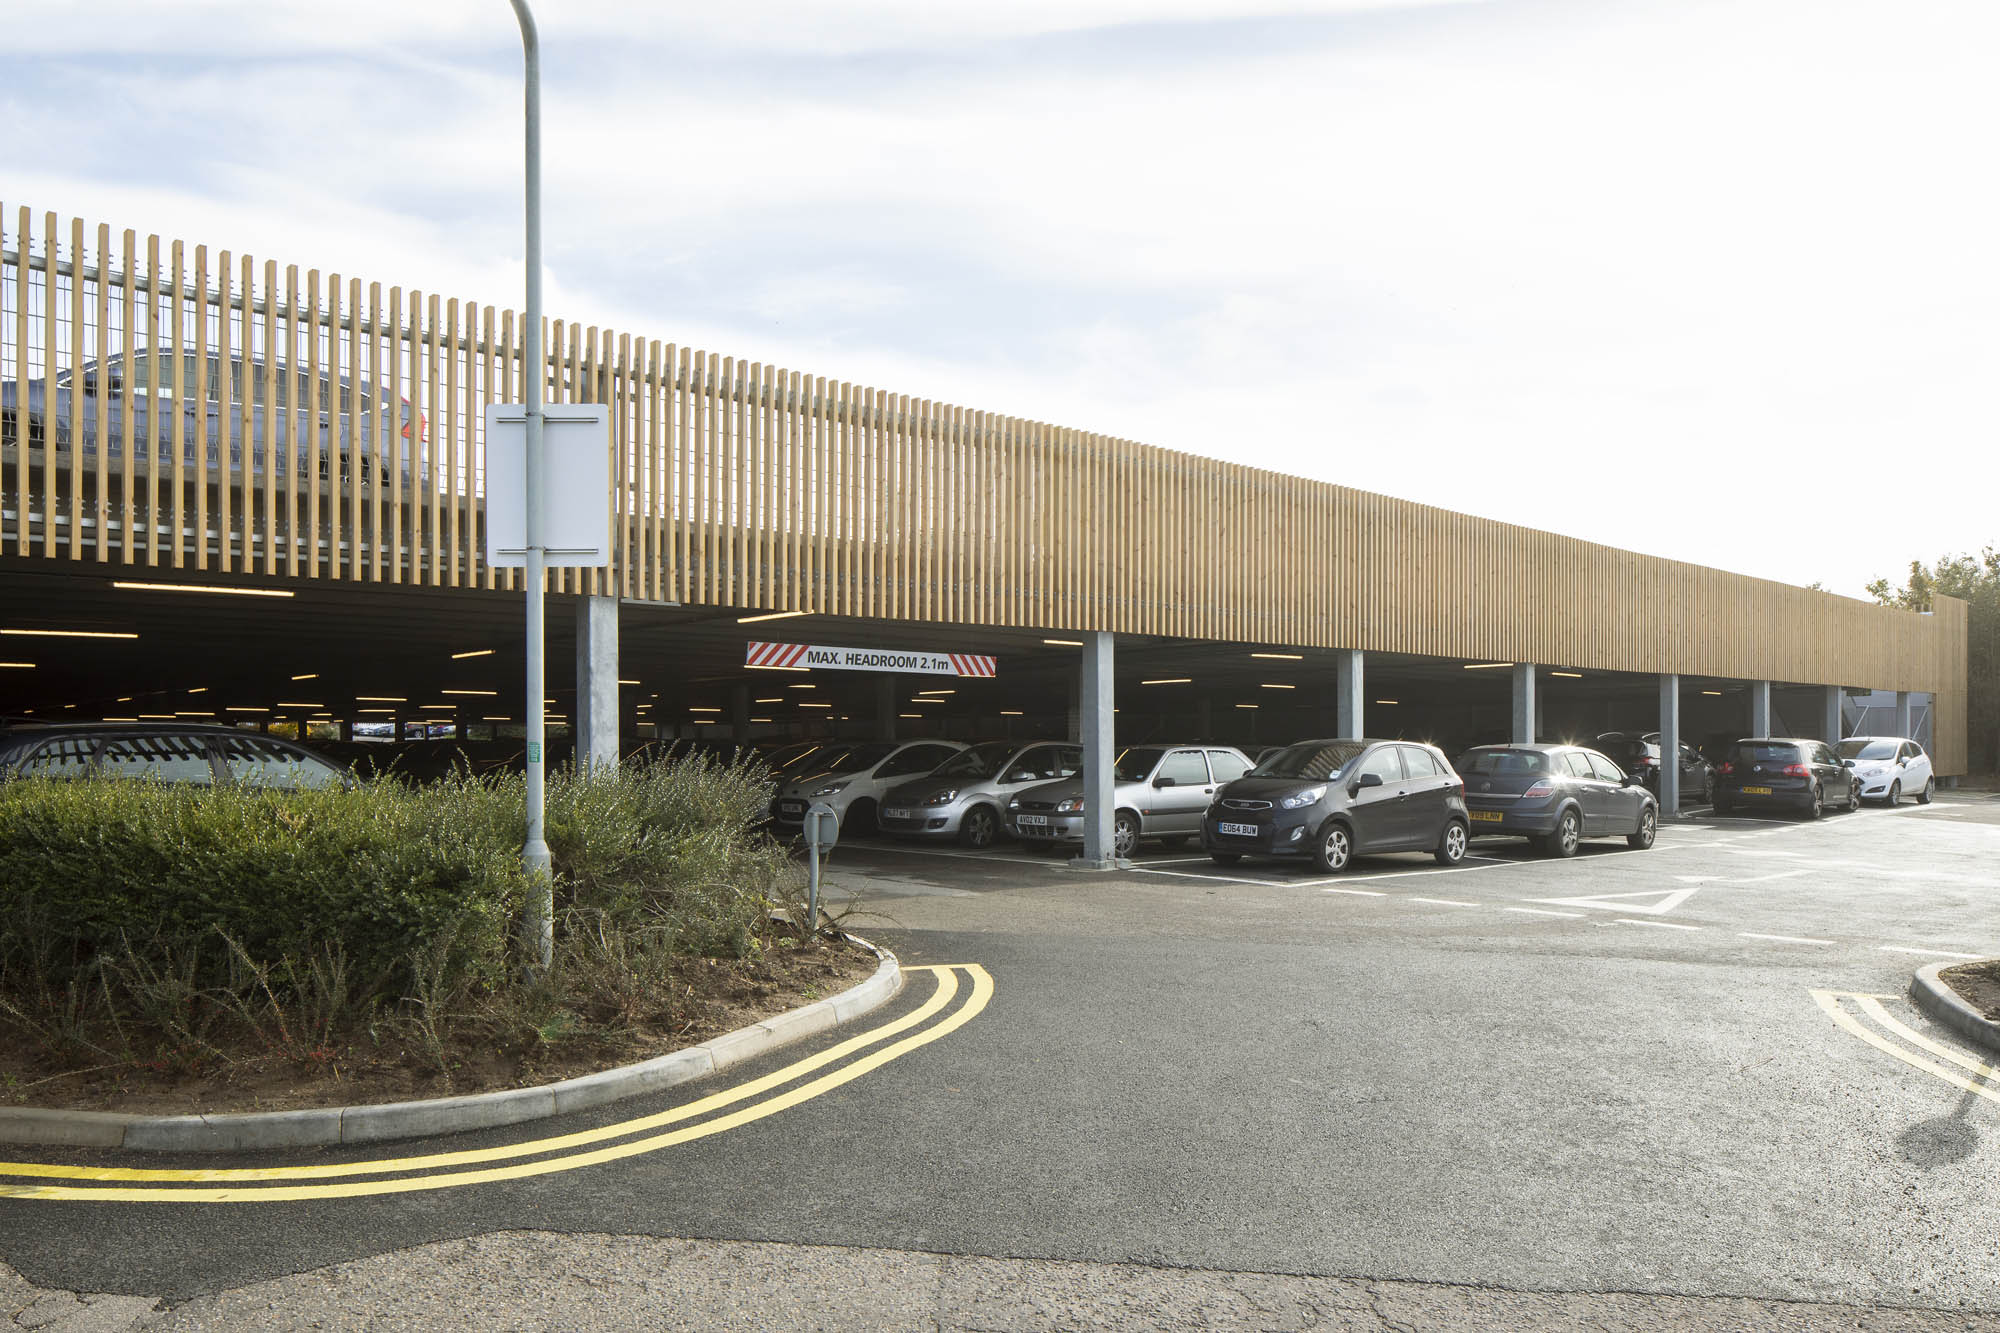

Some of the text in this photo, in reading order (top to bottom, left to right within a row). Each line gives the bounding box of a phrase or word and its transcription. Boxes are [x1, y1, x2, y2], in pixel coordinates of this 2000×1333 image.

[807, 650, 949, 670] MAX. HEADROOM 2.1m
